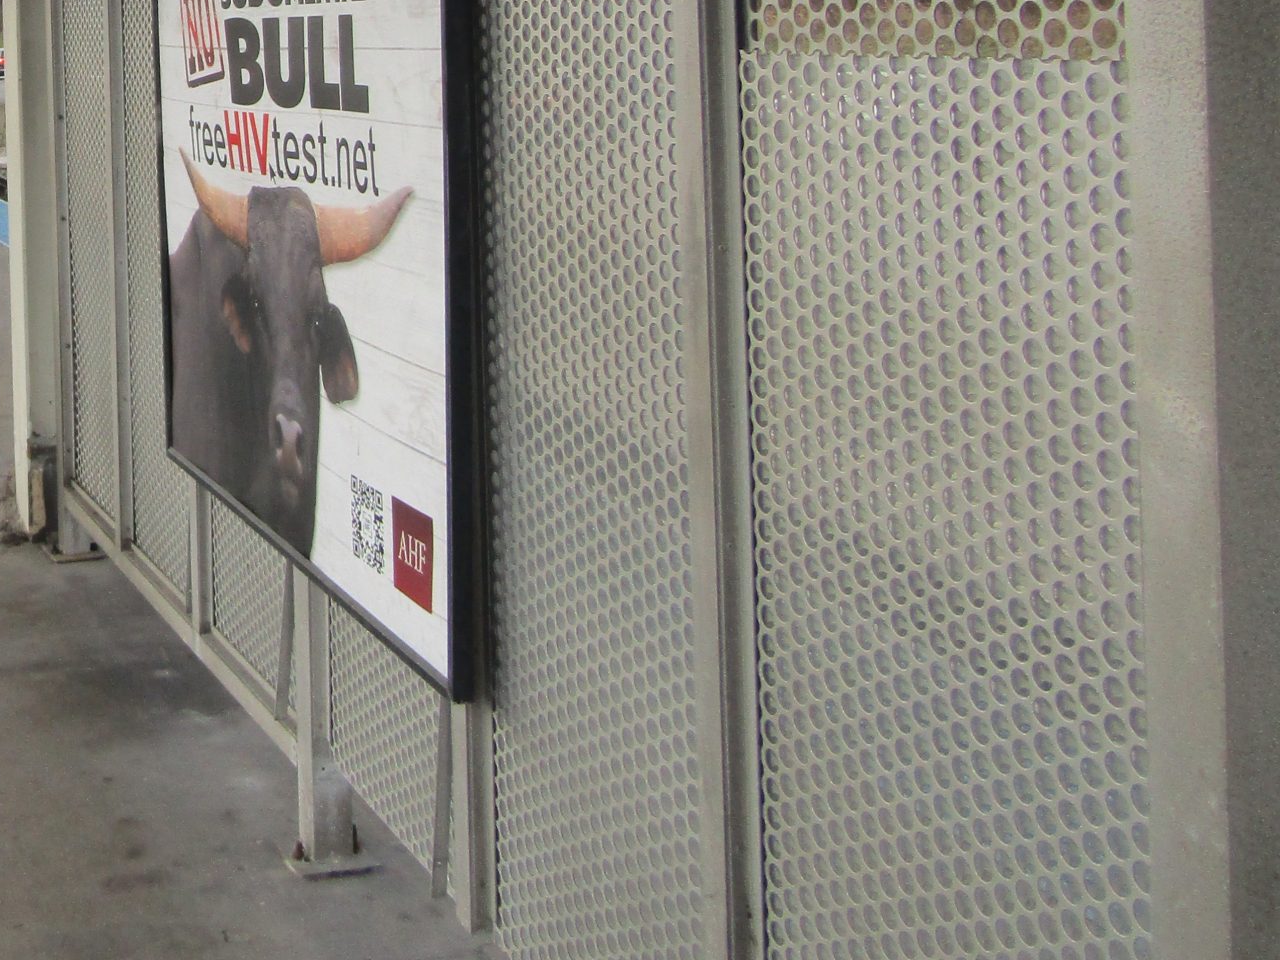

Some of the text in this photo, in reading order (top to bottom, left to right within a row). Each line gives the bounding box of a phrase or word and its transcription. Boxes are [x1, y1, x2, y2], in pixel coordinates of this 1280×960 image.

[224, 14, 370, 114] BULL
[189, 105, 380, 197] freeHIVtest.net
[398, 530, 427, 575] AHF
